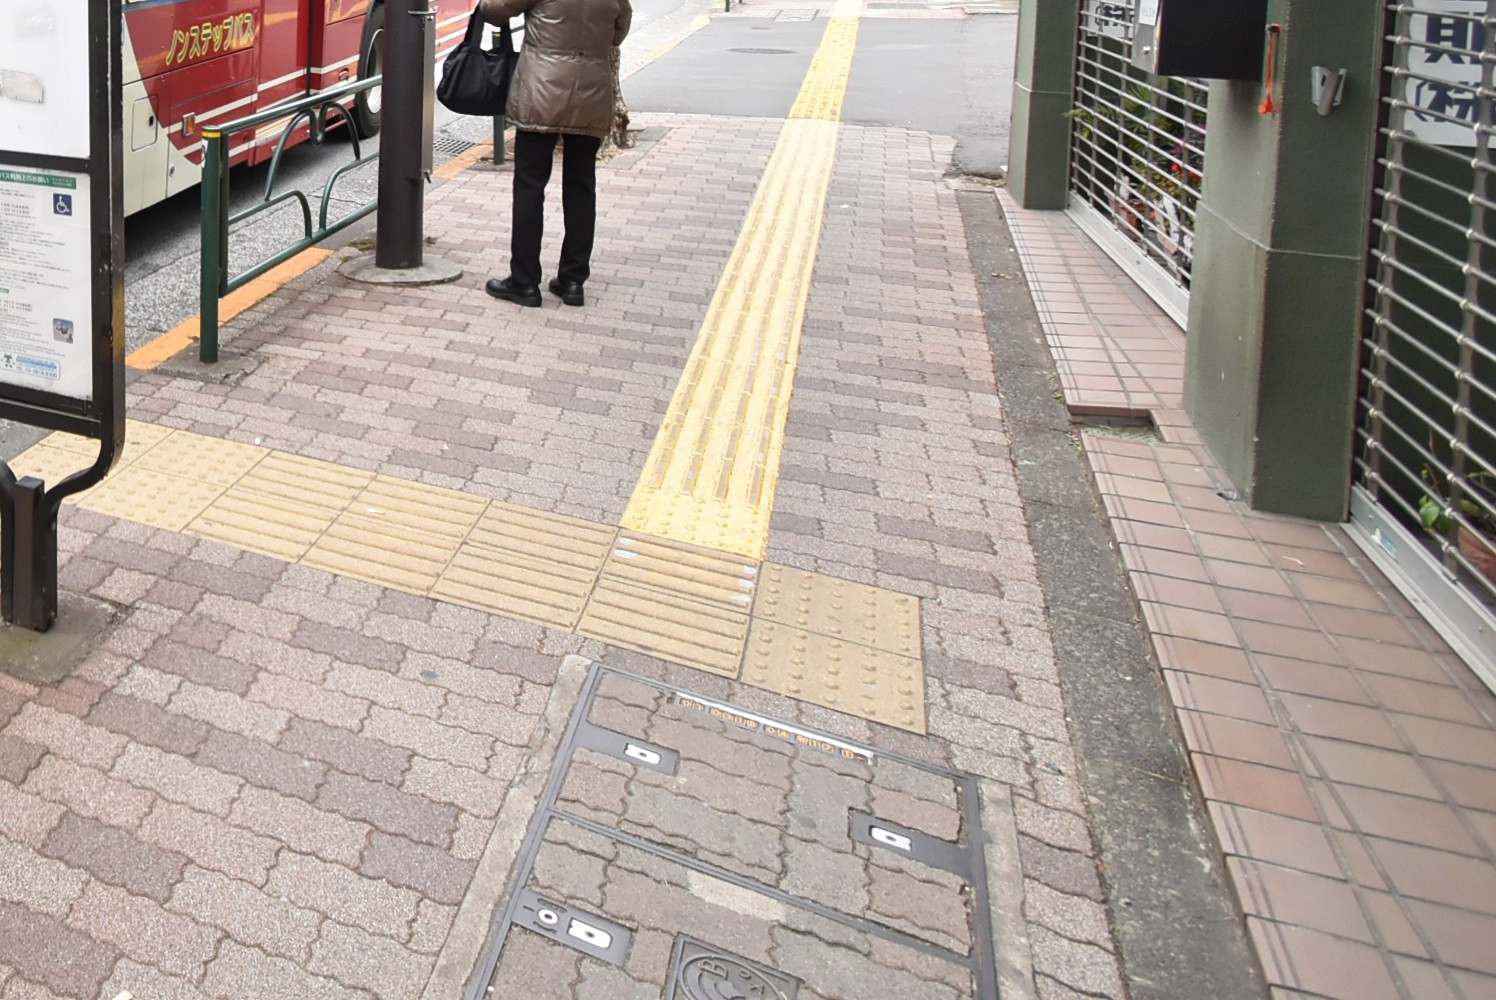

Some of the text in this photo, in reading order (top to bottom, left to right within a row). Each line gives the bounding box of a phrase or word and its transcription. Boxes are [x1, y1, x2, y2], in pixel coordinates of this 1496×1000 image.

[166, 13, 254, 65] ノンステップバス
